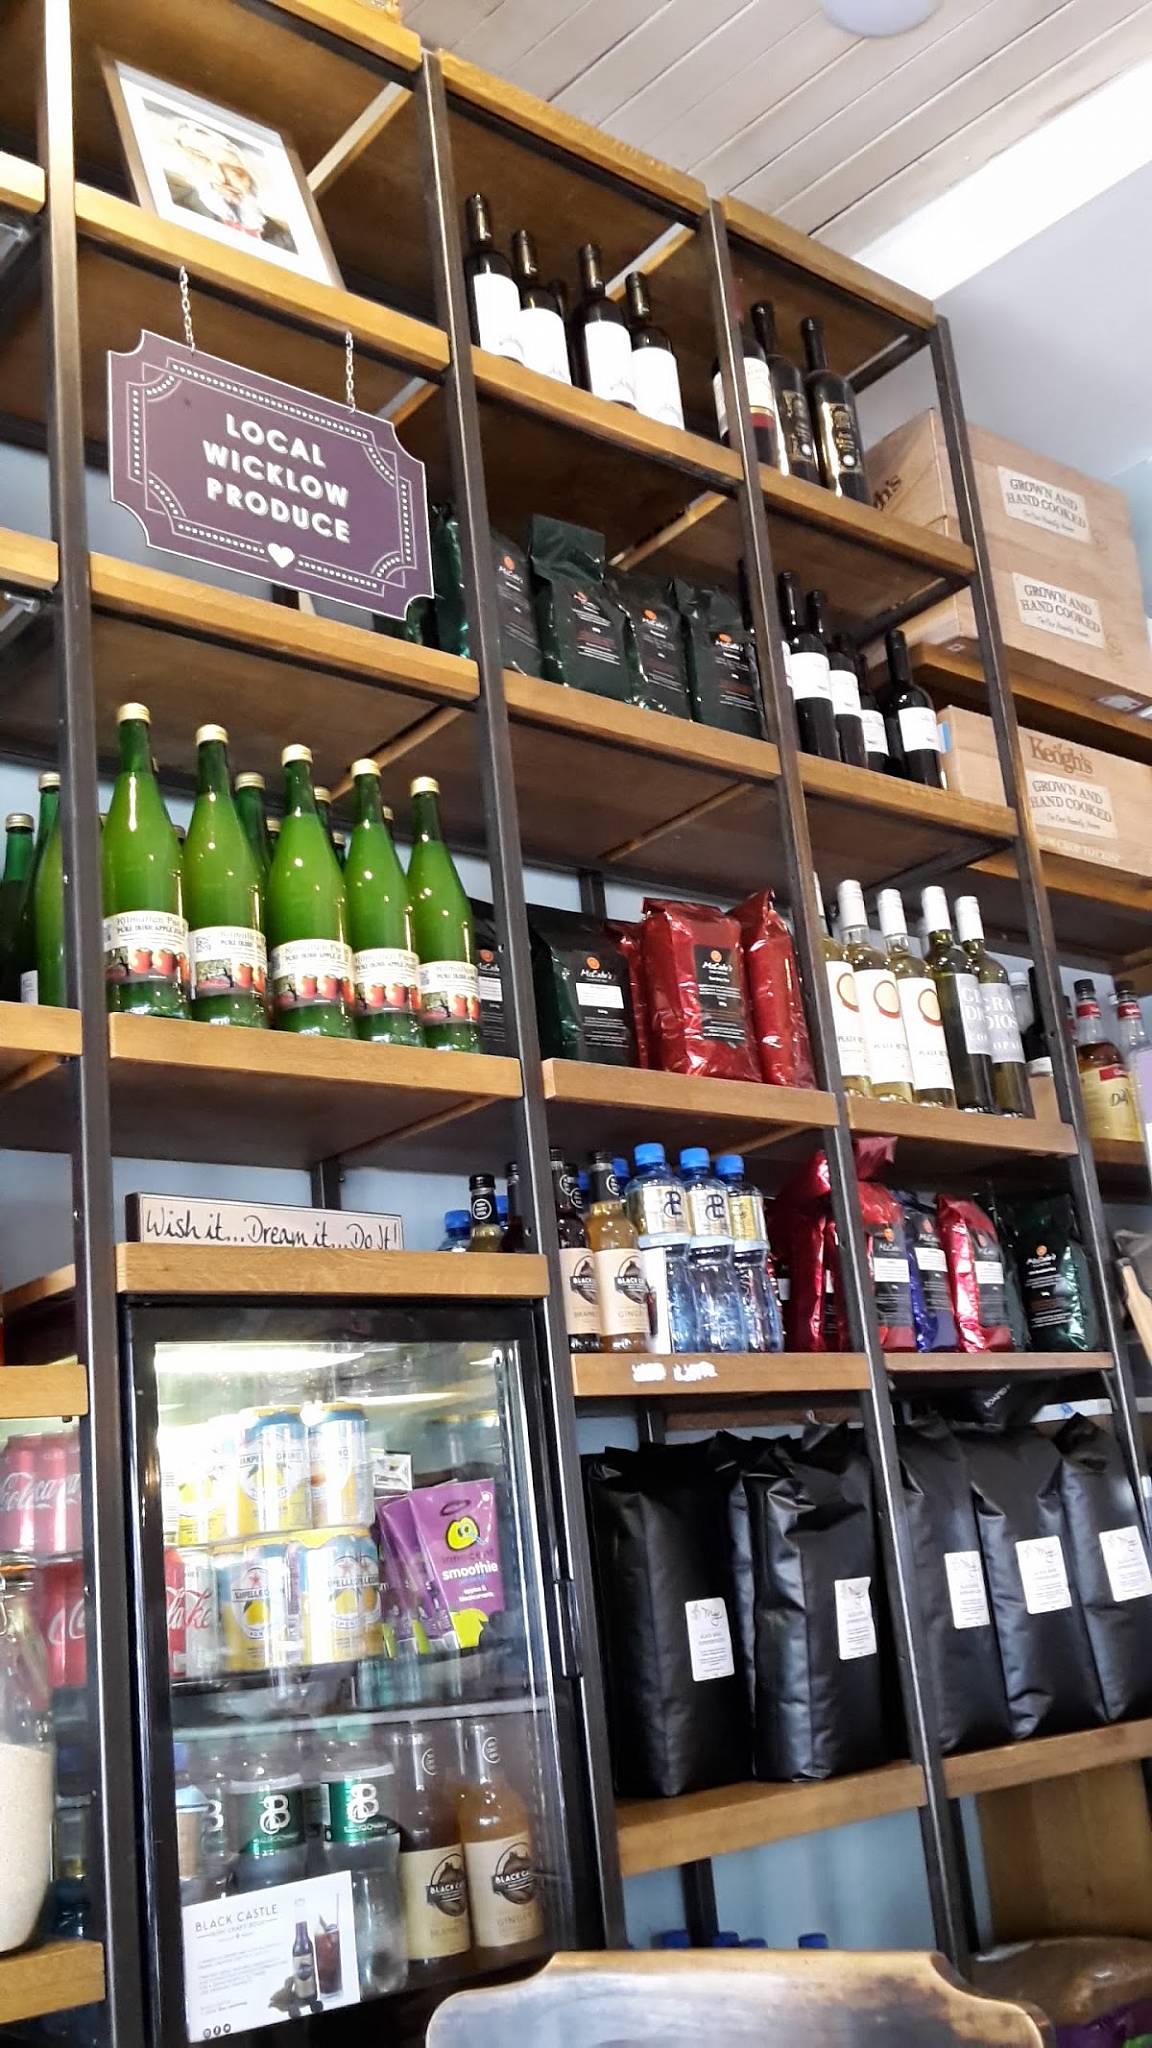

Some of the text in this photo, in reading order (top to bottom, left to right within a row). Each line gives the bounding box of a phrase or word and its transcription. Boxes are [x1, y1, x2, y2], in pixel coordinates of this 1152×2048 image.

[226, 413, 327, 468] LOCAL
[202, 440, 349, 508] WICKLOW
[206, 477, 350, 544] PRODUCE
[1007, 492, 1040, 507] HAND
[1040, 499, 1086, 529] COOKED
[1009, 479, 1078, 512] GROWN AND
[1020, 599, 1054, 614] HAND
[1055, 604, 1101, 633] COOKED
[1024, 584, 1092, 616] GROWN AND
[1032, 780, 1104, 805] GROWN AND
[1031, 796, 1064, 808] HAND
[1065, 798, 1113, 823] COOKED
[146, 1206, 201, 1240] Wish
[442, 1560, 498, 1581] smoothie
[495, 1872, 520, 1884] BLACK
[195, 1904, 278, 1932] BLACK CASTLE
